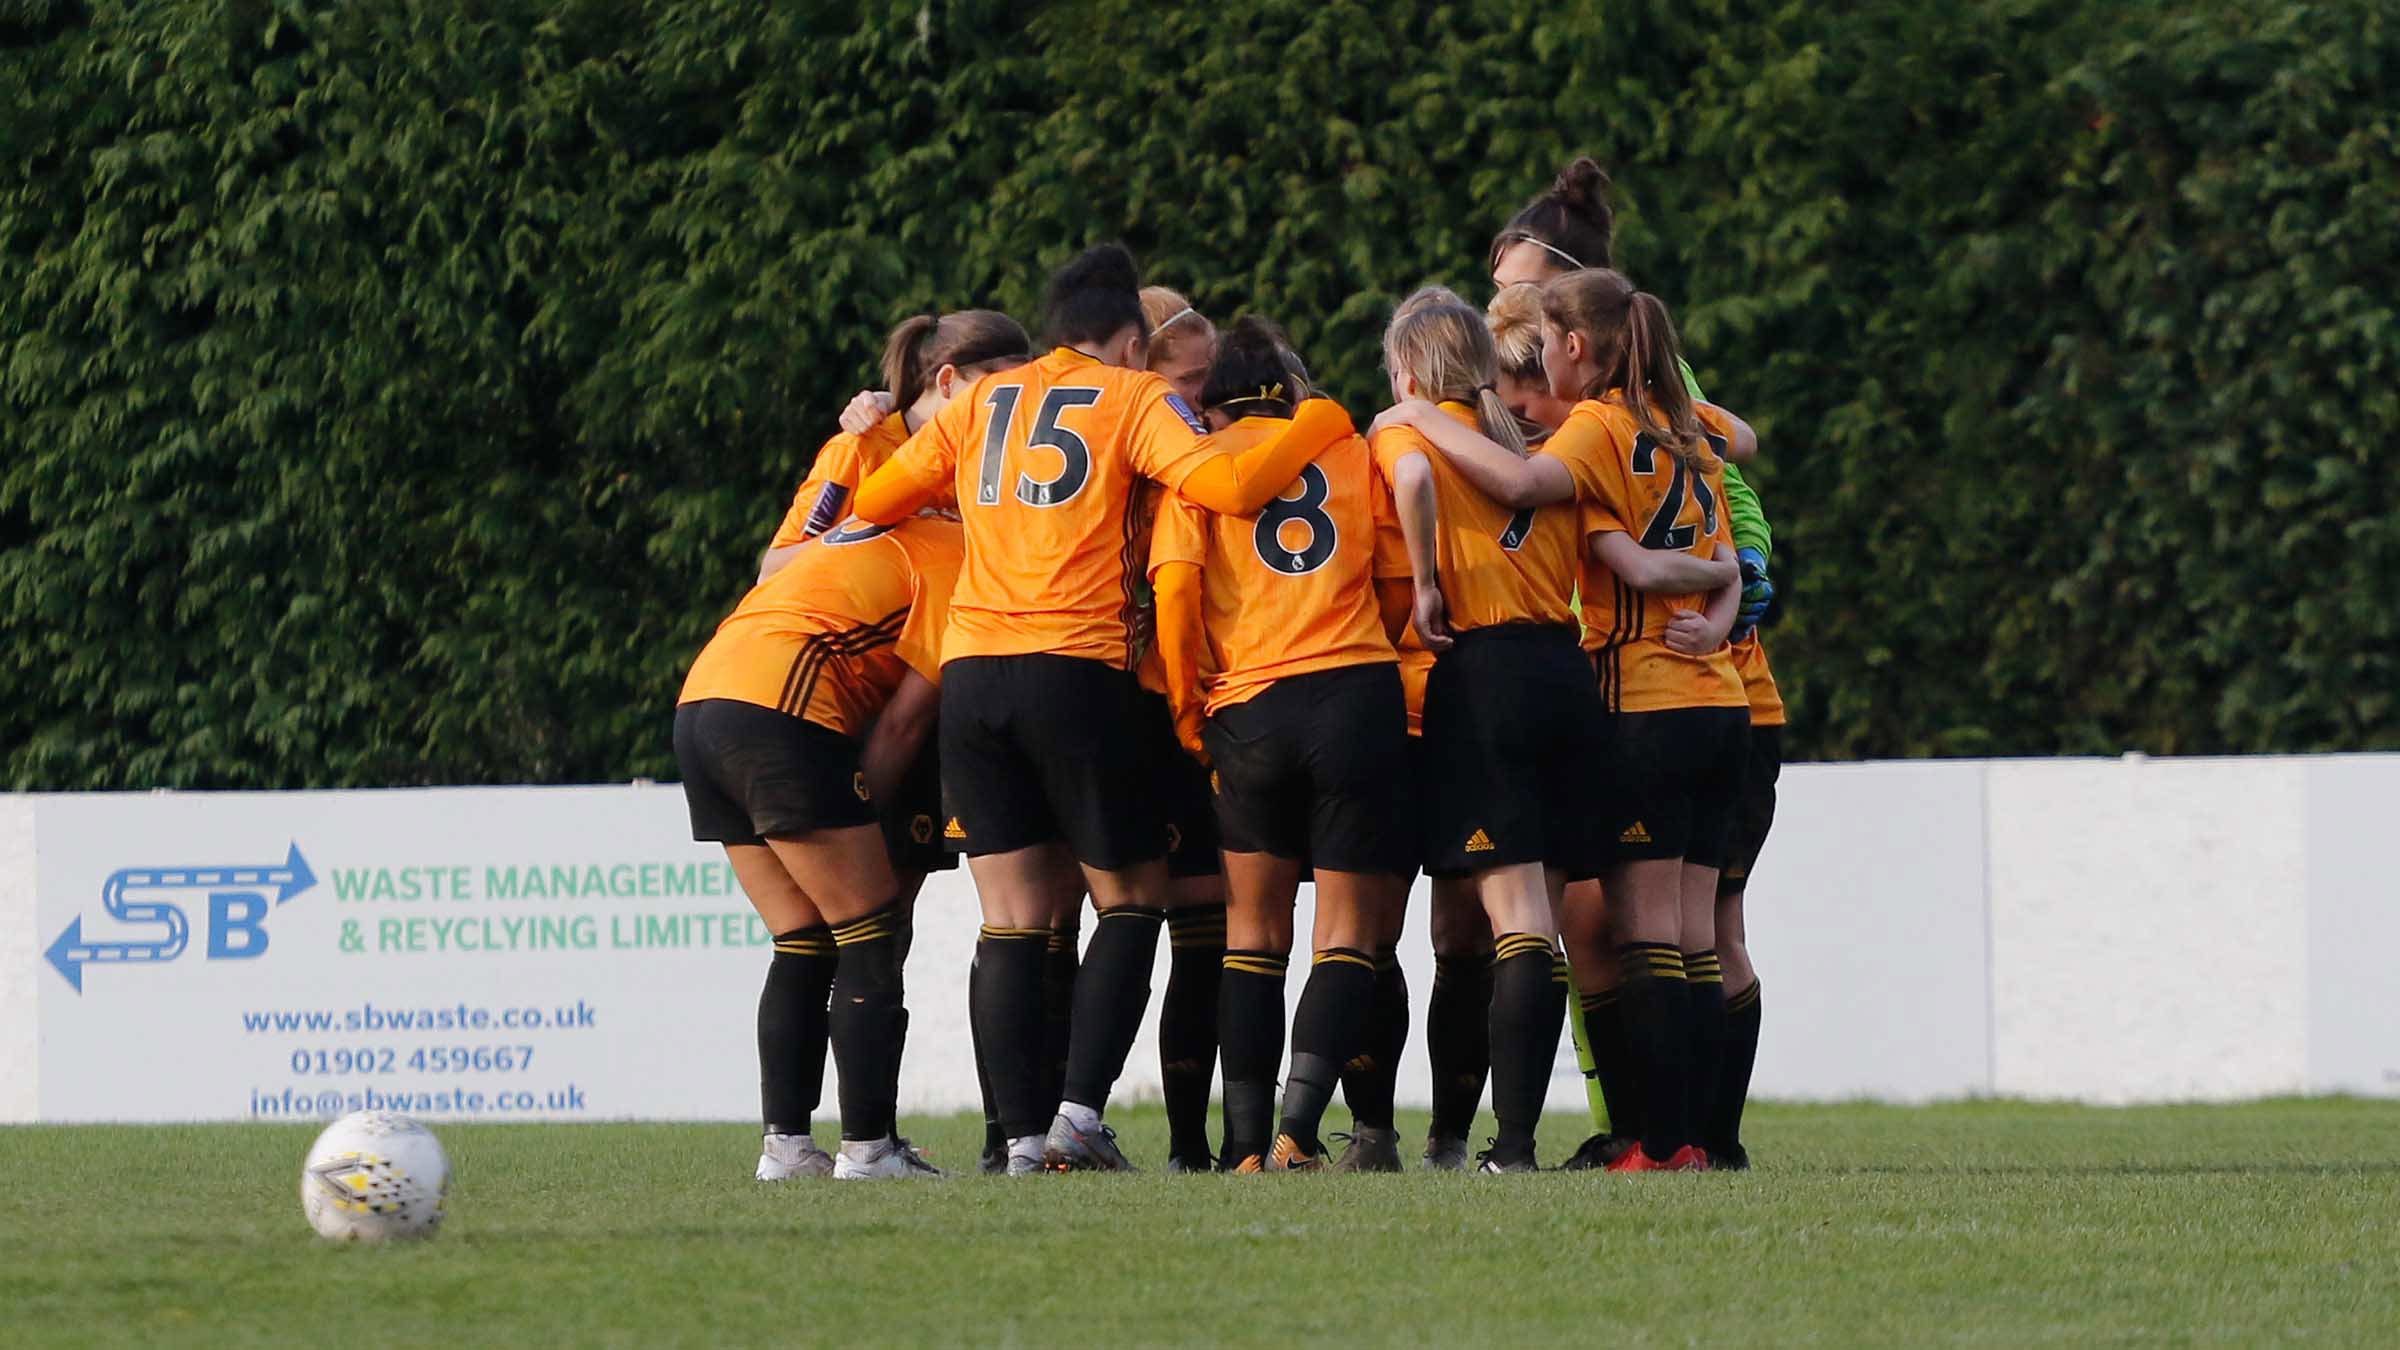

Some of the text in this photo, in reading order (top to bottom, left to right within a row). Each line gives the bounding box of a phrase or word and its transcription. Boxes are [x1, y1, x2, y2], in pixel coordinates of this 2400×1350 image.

[976, 384, 1104, 508] 15
[1253, 462, 1338, 576] 8
[331, 866, 472, 902] WASTE
[338, 911, 772, 952] & REYCLYING LIMITED
[242, 999, 596, 1032] www.sbwaste.co.uk
[291, 1045, 534, 1074] 01902 459667
[250, 1083, 586, 1115] info@sbwaste.co.uk
